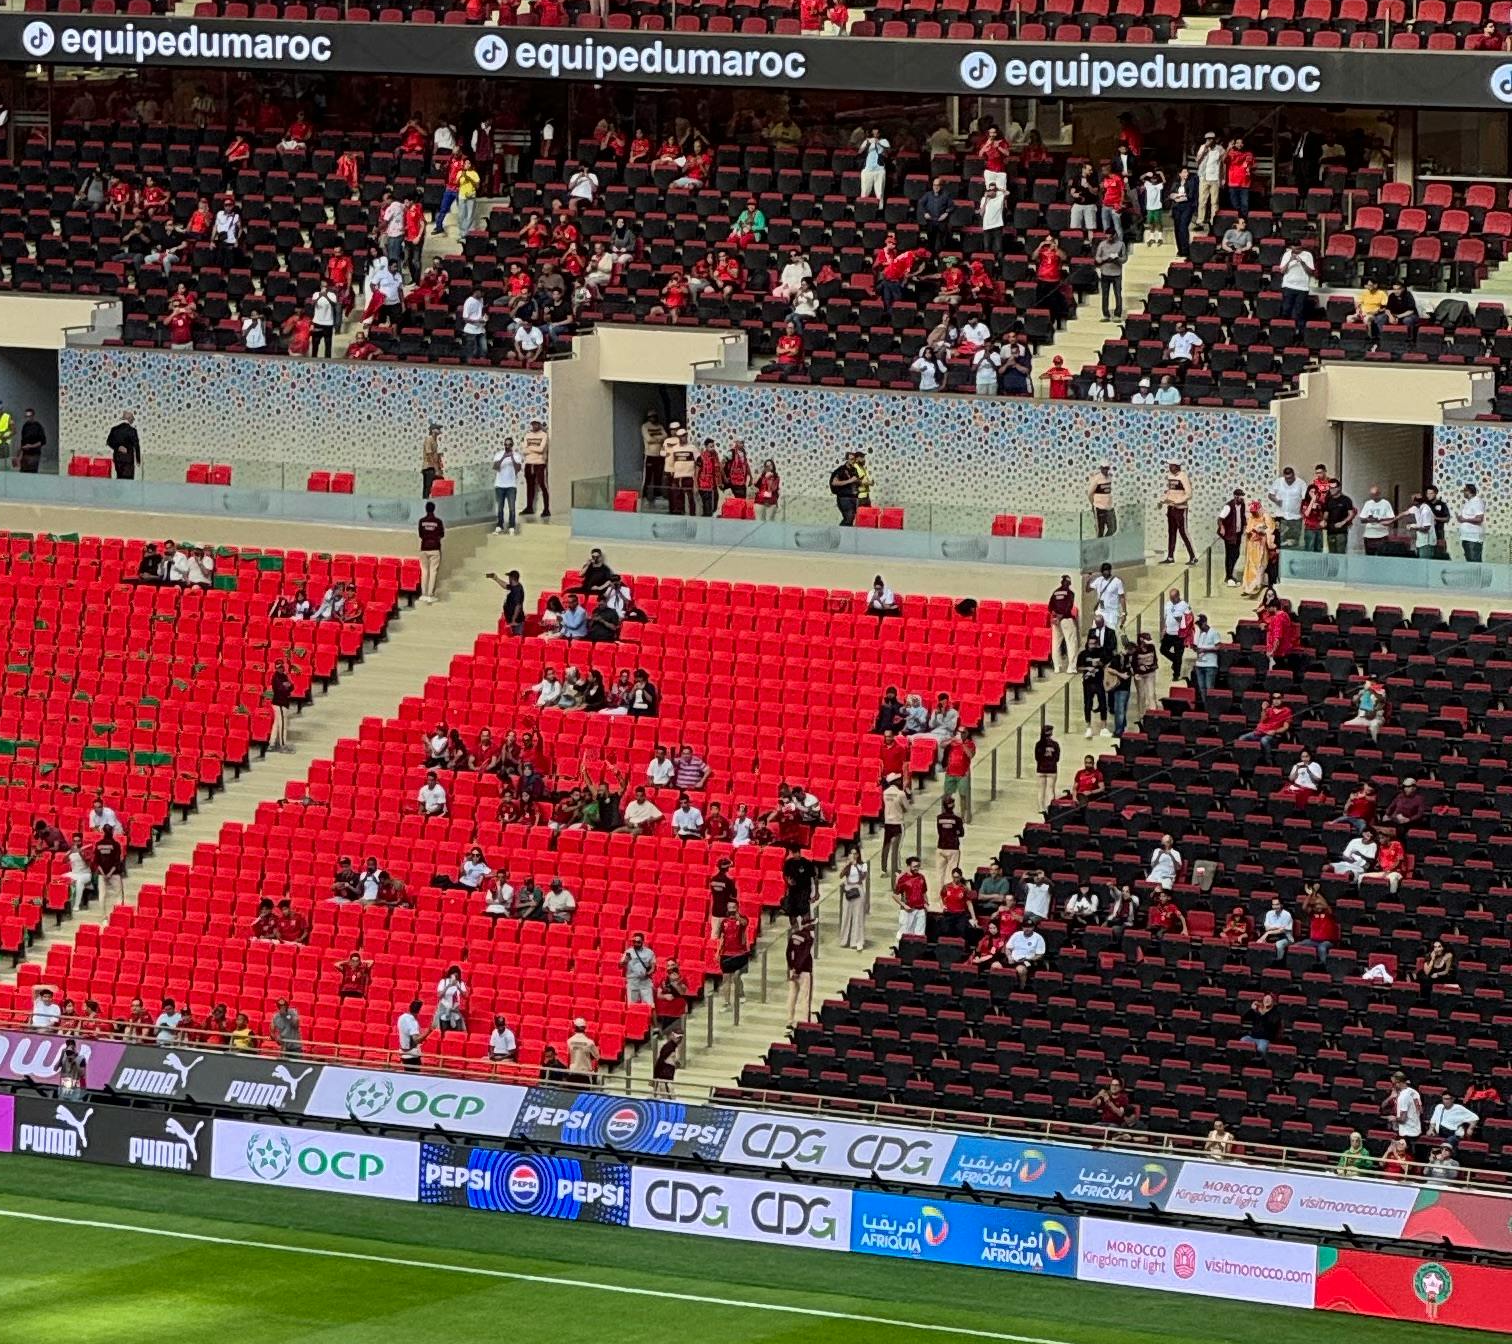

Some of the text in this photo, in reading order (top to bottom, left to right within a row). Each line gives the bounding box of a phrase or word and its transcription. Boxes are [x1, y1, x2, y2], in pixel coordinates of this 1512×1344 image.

[62, 21, 331, 62] equipedumaroc
[516, 35, 806, 78] equipedumaroc
[1005, 53, 1321, 94] equipedumaroc
[117, 1066, 178, 1095] PUMA
[224, 1079, 283, 1107] PUMA
[396, 1088, 486, 1120] OCP
[523, 1104, 592, 1130] PEPSI
[20, 1125, 79, 1156] PUMA
[653, 1119, 726, 1147] PEPSI
[741, 1123, 827, 1163] CDG
[129, 1136, 189, 1167] PUMA
[298, 1146, 384, 1182] OCP
[846, 1133, 934, 1178] CDG
[425, 1163, 491, 1192] PEPSI
[512, 1179, 537, 1189] PEPSI
[950, 1169, 1012, 1188] AFRIQUIA
[1203, 1180, 1263, 1197] MOROCCO
[557, 1178, 624, 1207] PEPSI
[645, 1179, 730, 1229] CDG
[1071, 1183, 1133, 1202] AFRIQUIA
[1175, 1188, 1259, 1210] Kingdom of light
[751, 1191, 837, 1241] CDG
[1299, 1195, 1407, 1219] visitmorocco.com
[860, 1233, 922, 1254] AFRIQUIA
[981, 1246, 1043, 1267] AFRIQUIA
[1106, 1239, 1166, 1258] MOROCCO
[1082, 1250, 1166, 1275] Kingdom of light
[1204, 1257, 1313, 1285] visitmorocco.com
